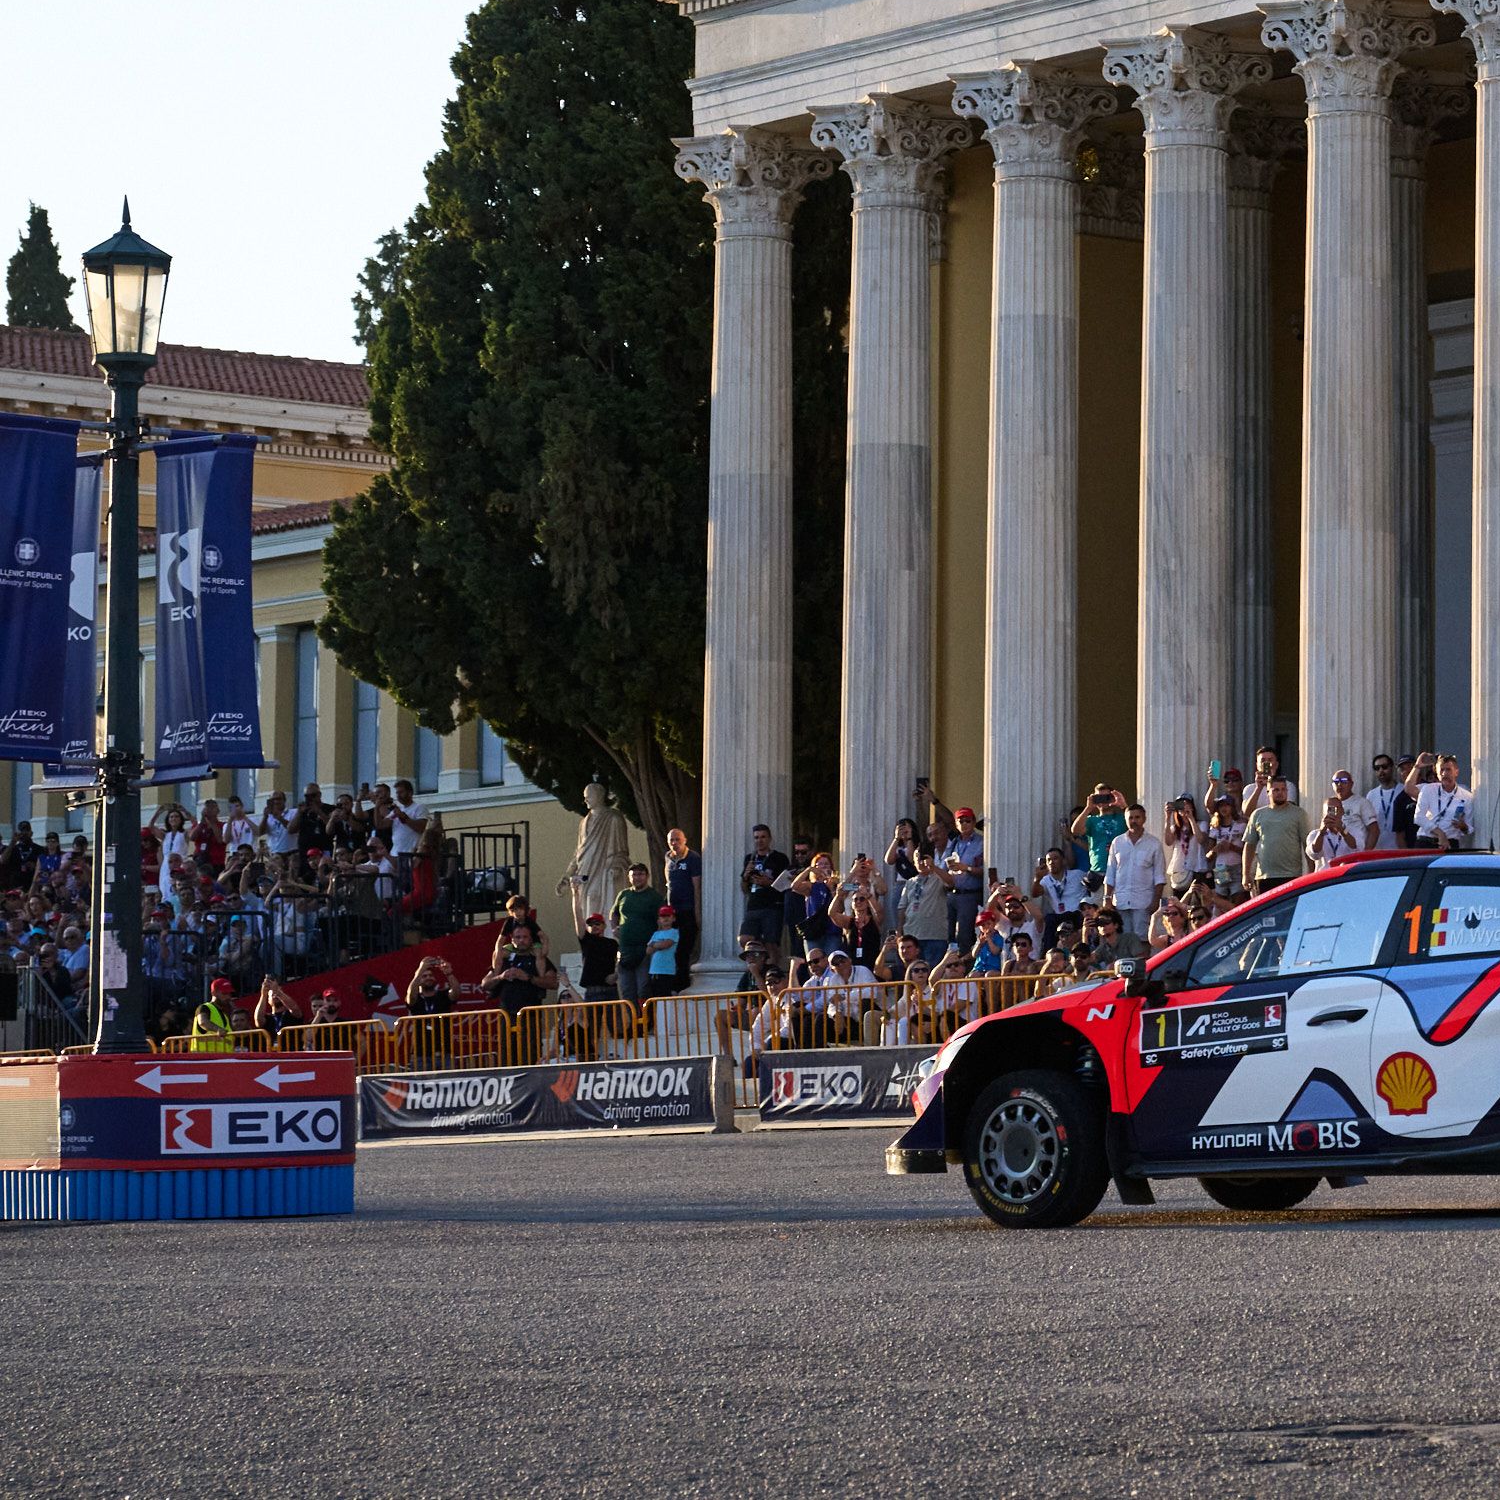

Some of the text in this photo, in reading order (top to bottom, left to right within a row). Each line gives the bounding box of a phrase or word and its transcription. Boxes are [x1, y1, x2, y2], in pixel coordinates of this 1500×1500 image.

[26, 571, 63, 580] REPUBLIC
[32, 581, 53, 589] Sports
[67, 626, 92, 641] KO
[1404, 905, 1422, 955] 1
[1156, 1014, 1166, 1047] 1
[1212, 1025, 1231, 1034] RALLY
[1242, 1022, 1260, 1030] GODS
[1181, 1043, 1249, 1060] SafetyCulture
[800, 1071, 860, 1100] EKO
[431, 1109, 513, 1128] driving emotion
[604, 1101, 690, 1122] driving emotion
[228, 1107, 339, 1145] EKO
[1192, 1133, 1262, 1150] HYUNDAI
[1267, 1120, 1361, 1152] MOBIS
